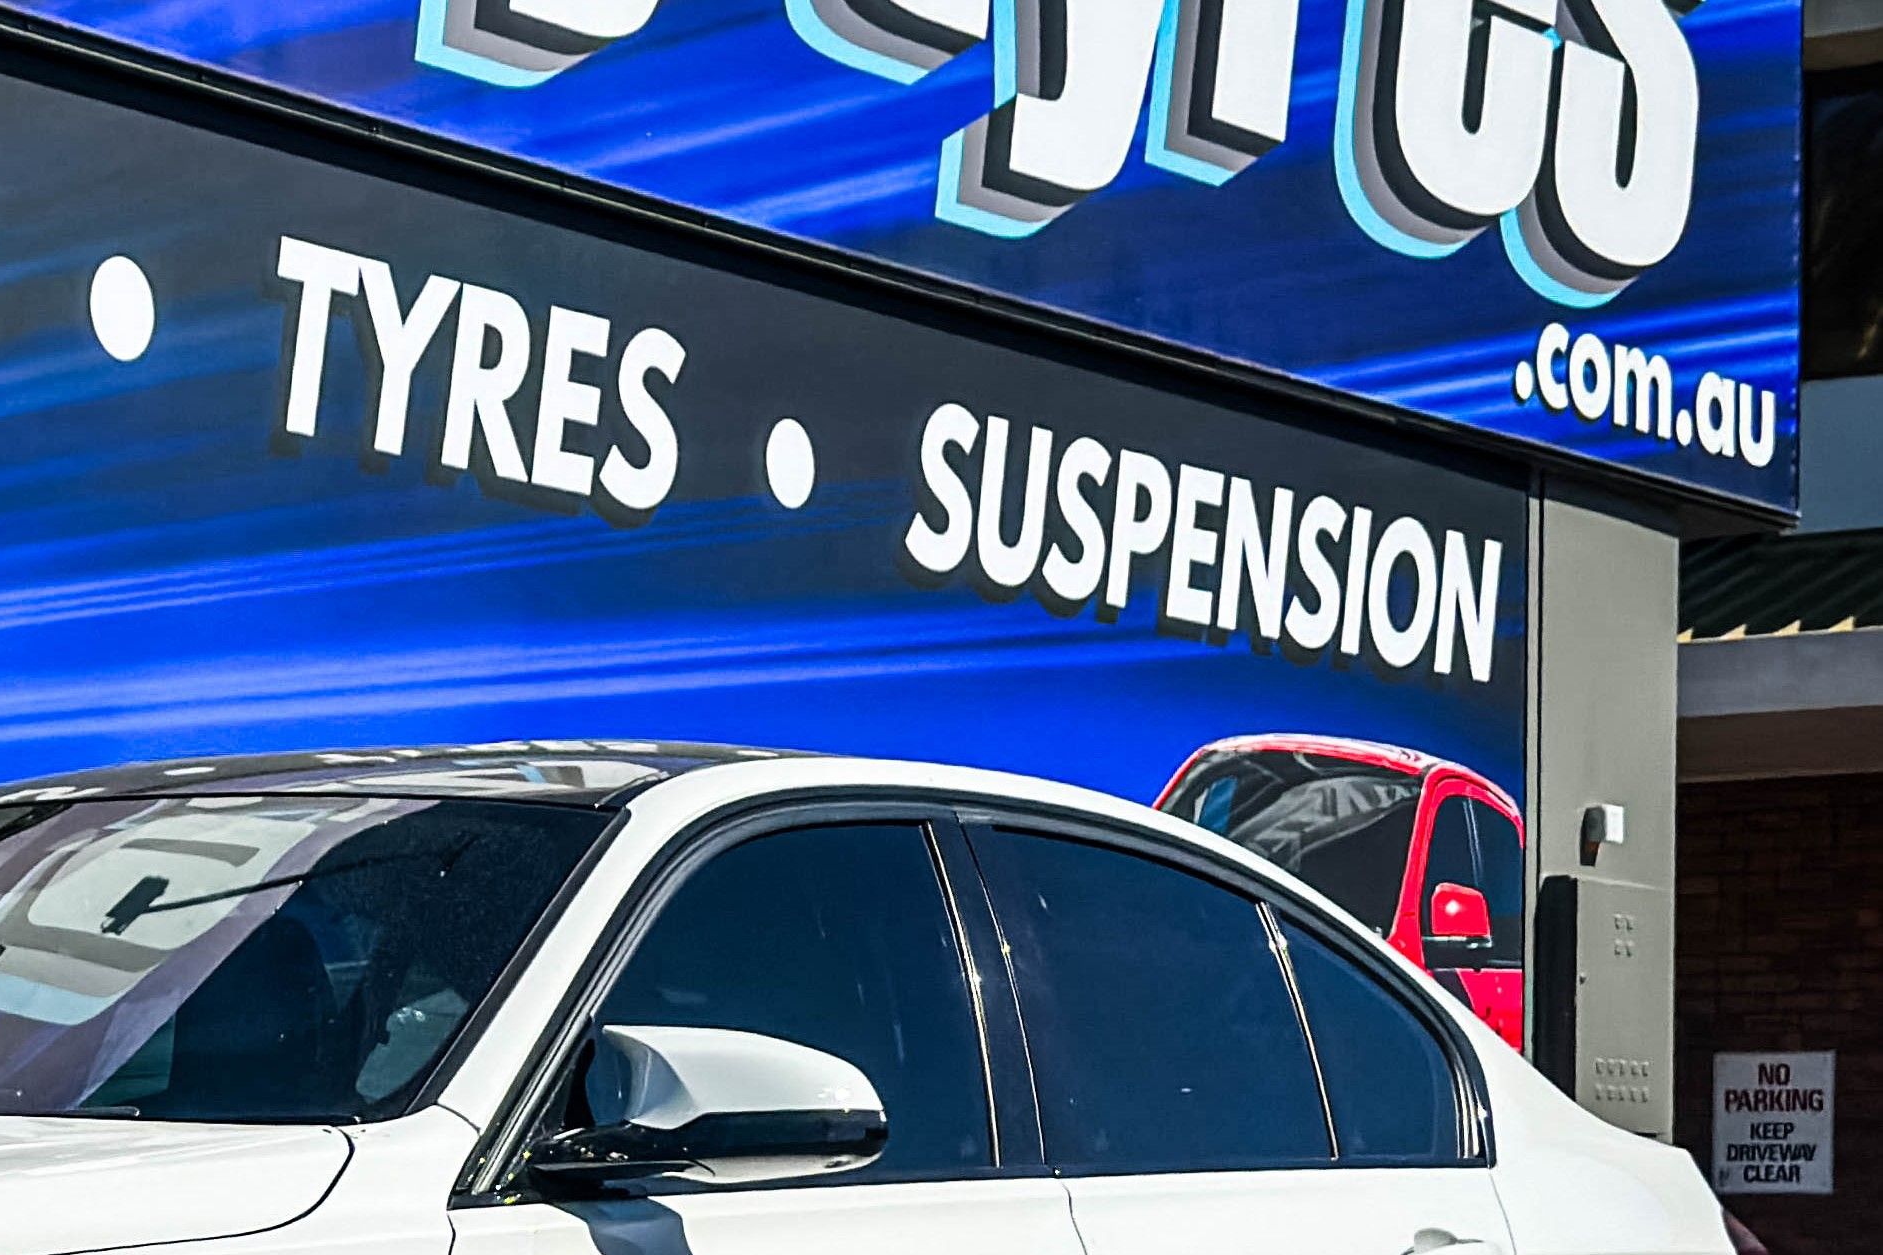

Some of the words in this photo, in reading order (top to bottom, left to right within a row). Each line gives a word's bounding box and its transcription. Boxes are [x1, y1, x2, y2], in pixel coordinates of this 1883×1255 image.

[1516, 323, 1775, 467] .com.au
[278, 236, 686, 511] TYRES
[907, 402, 1503, 681] SUSPENSION
[1758, 1063, 1791, 1086] NO
[1724, 1089, 1824, 1113] PARKING
[1749, 1122, 1795, 1140] KEEP
[1726, 1144, 1817, 1162] DRIVEWAY
[1743, 1164, 1801, 1182] CLEAR
